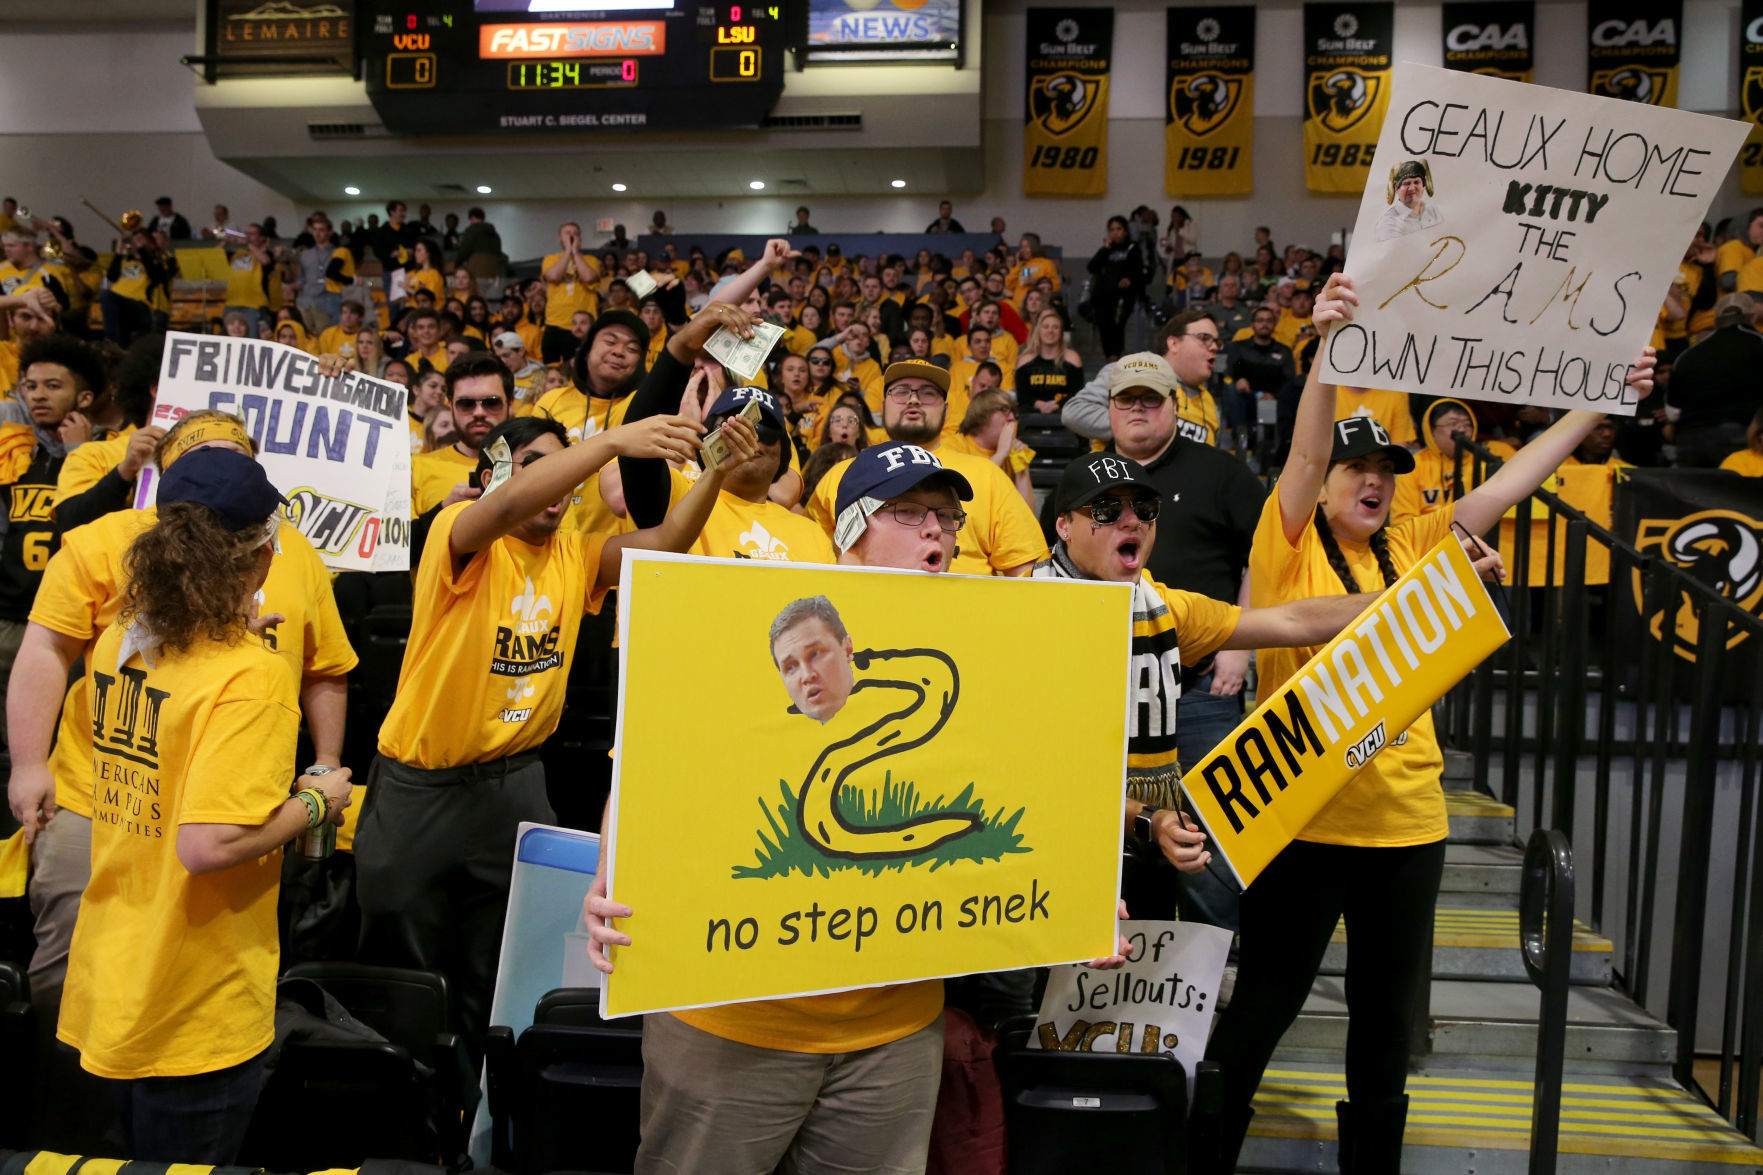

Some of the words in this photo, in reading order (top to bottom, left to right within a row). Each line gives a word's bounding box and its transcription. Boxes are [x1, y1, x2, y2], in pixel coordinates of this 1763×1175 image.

[406, 14, 417, 29] 0
[443, 14, 453, 27] 4
[731, 6, 741, 21] 0
[768, 6, 778, 20] 4
[226, 20, 349, 41] LEMAIRE
[718, 26, 755, 44] LSU
[840, 16, 929, 40] NEWS
[1446, 23, 1528, 50] CAA
[1591, 18, 1676, 47] CAA
[394, 33, 430, 50] VCU
[739, 51, 755, 76] 0
[1030, 59, 1107, 69] CHAMPIONS
[1171, 58, 1249, 69] CHAMPIONS
[1307, 54, 1389, 66] CHAMPIONS
[1446, 50, 1528, 60] CHAMPIONS
[415, 58, 429, 82] 0
[520, 62, 580, 87] 11:34
[501, 116, 543, 127] STUART
[546, 116, 557, 127] C.
[559, 115, 599, 126] SIEGEL
[602, 113, 647, 125] CENTER
[1030, 146, 1099, 170] 1980
[1177, 147, 1240, 170] 1981
[1312, 143, 1377, 167] 1985
[1401, 100, 1566, 171] GEAUX
[1574, 126, 1712, 198] HOME
[1502, 179, 1609, 224] KITTY
[1518, 222, 1577, 262] THE
[1377, 235, 1642, 337] RAMS
[168, 338, 232, 385] FBI
[1329, 323, 1438, 385] OWN
[1450, 336, 1526, 395] THIS
[1529, 346, 1638, 406] HOUSE
[732, 386, 775, 410] FBI
[208, 391, 393, 470] OUNT
[1338, 416, 1390, 446] FB
[877, 444, 943, 473] FBI
[1088, 457, 1134, 484] FBI
[12, 488, 57, 519] VC
[290, 490, 372, 553] VCU
[494, 626, 560, 661] RAMS
[500, 708, 532, 723] VCU
[1347, 721, 1385, 767] VCU
[706, 916, 759, 953] no
[777, 902, 878, 952] step
[895, 899, 942, 934] on
[957, 879, 1050, 929] snek
[1068, 971, 1207, 1013] Sellouts:
